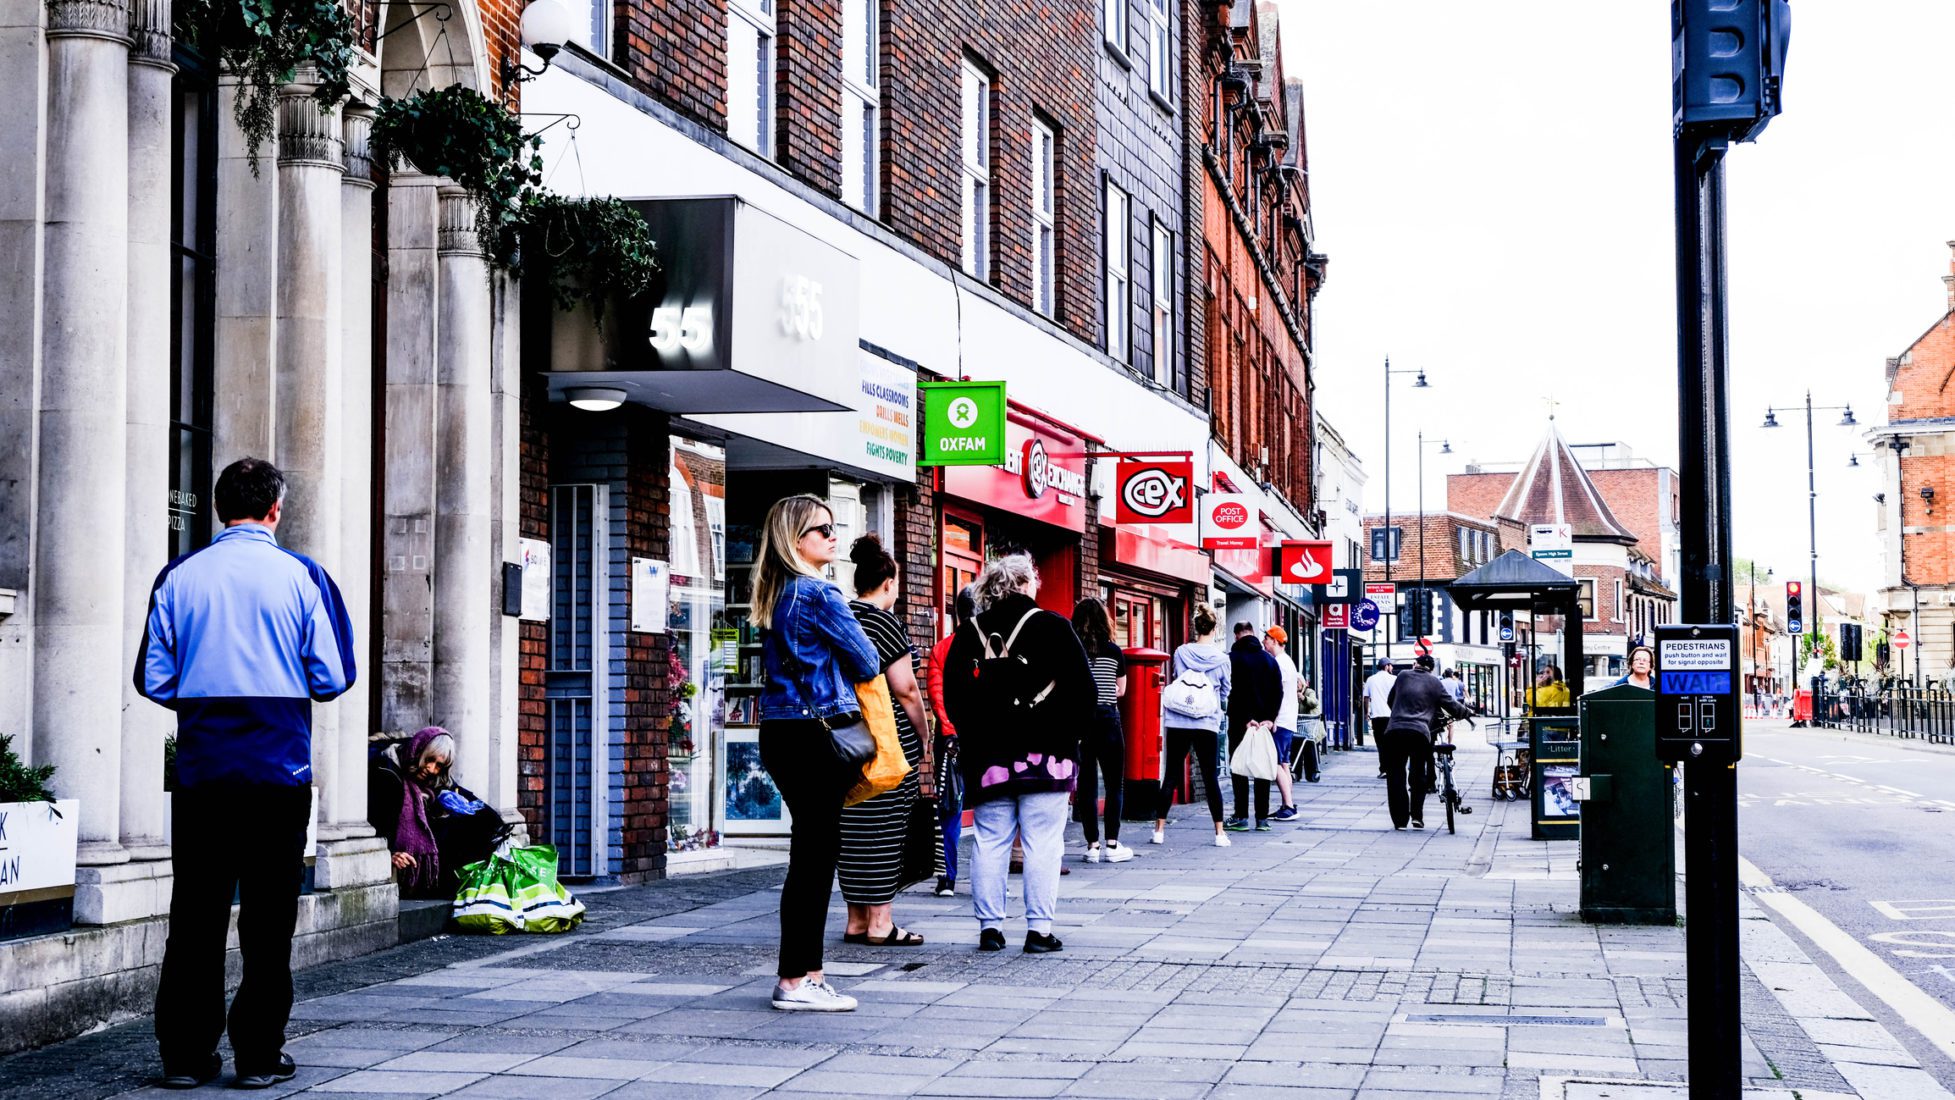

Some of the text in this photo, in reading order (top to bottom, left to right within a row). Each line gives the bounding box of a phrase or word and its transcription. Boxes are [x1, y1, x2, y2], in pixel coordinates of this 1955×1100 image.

[649, 306, 710, 350] 55
[862, 380, 909, 409] FILLS CLASSROOMS
[893, 410, 909, 428] WELLS
[940, 437, 986, 451] OXFAM
[866, 441, 908, 466] FIGHTS POVERTY
[169, 489, 197, 508] NEBAKED
[1215, 515, 1244, 523] OFFICE
[1559, 528, 1567, 538] K
[1666, 674, 1725, 691] WAIT
[1550, 745, 1571, 753] Litter
[0, 811, 8, 841] K
[0, 855, 20, 886] AN
